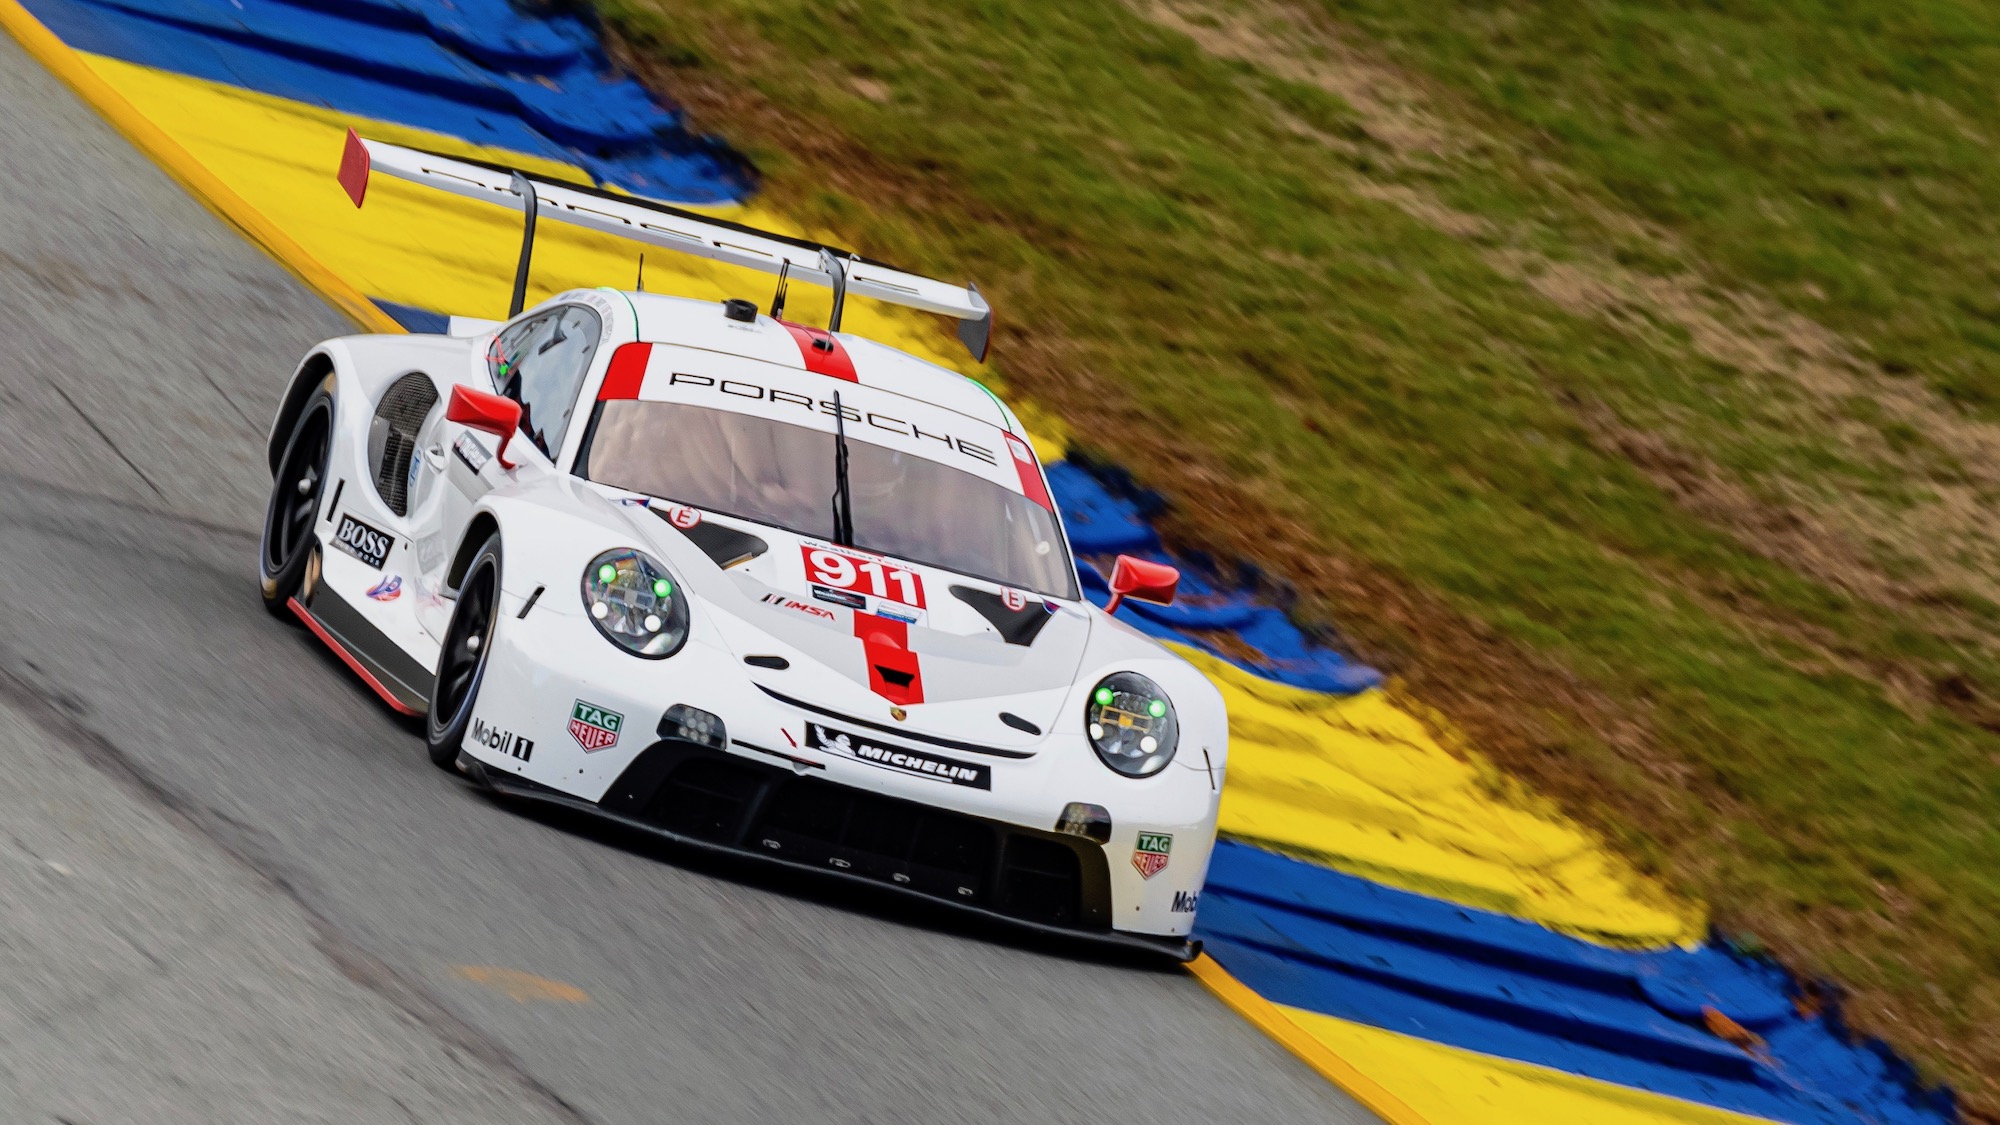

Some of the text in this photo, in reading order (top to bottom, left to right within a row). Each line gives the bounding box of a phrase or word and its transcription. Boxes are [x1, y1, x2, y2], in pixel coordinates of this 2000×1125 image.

[668, 372, 997, 466] PORSCHE
[338, 518, 389, 559] BOSS
[809, 550, 919, 606] 911
[784, 600, 835, 622] IMSA
[578, 704, 618, 730] TAG
[471, 717, 531, 761] Mobil 1
[571, 723, 615, 749] HEUER
[857, 744, 978, 781] MICHELIN
[1141, 835, 1169, 852] TAG
